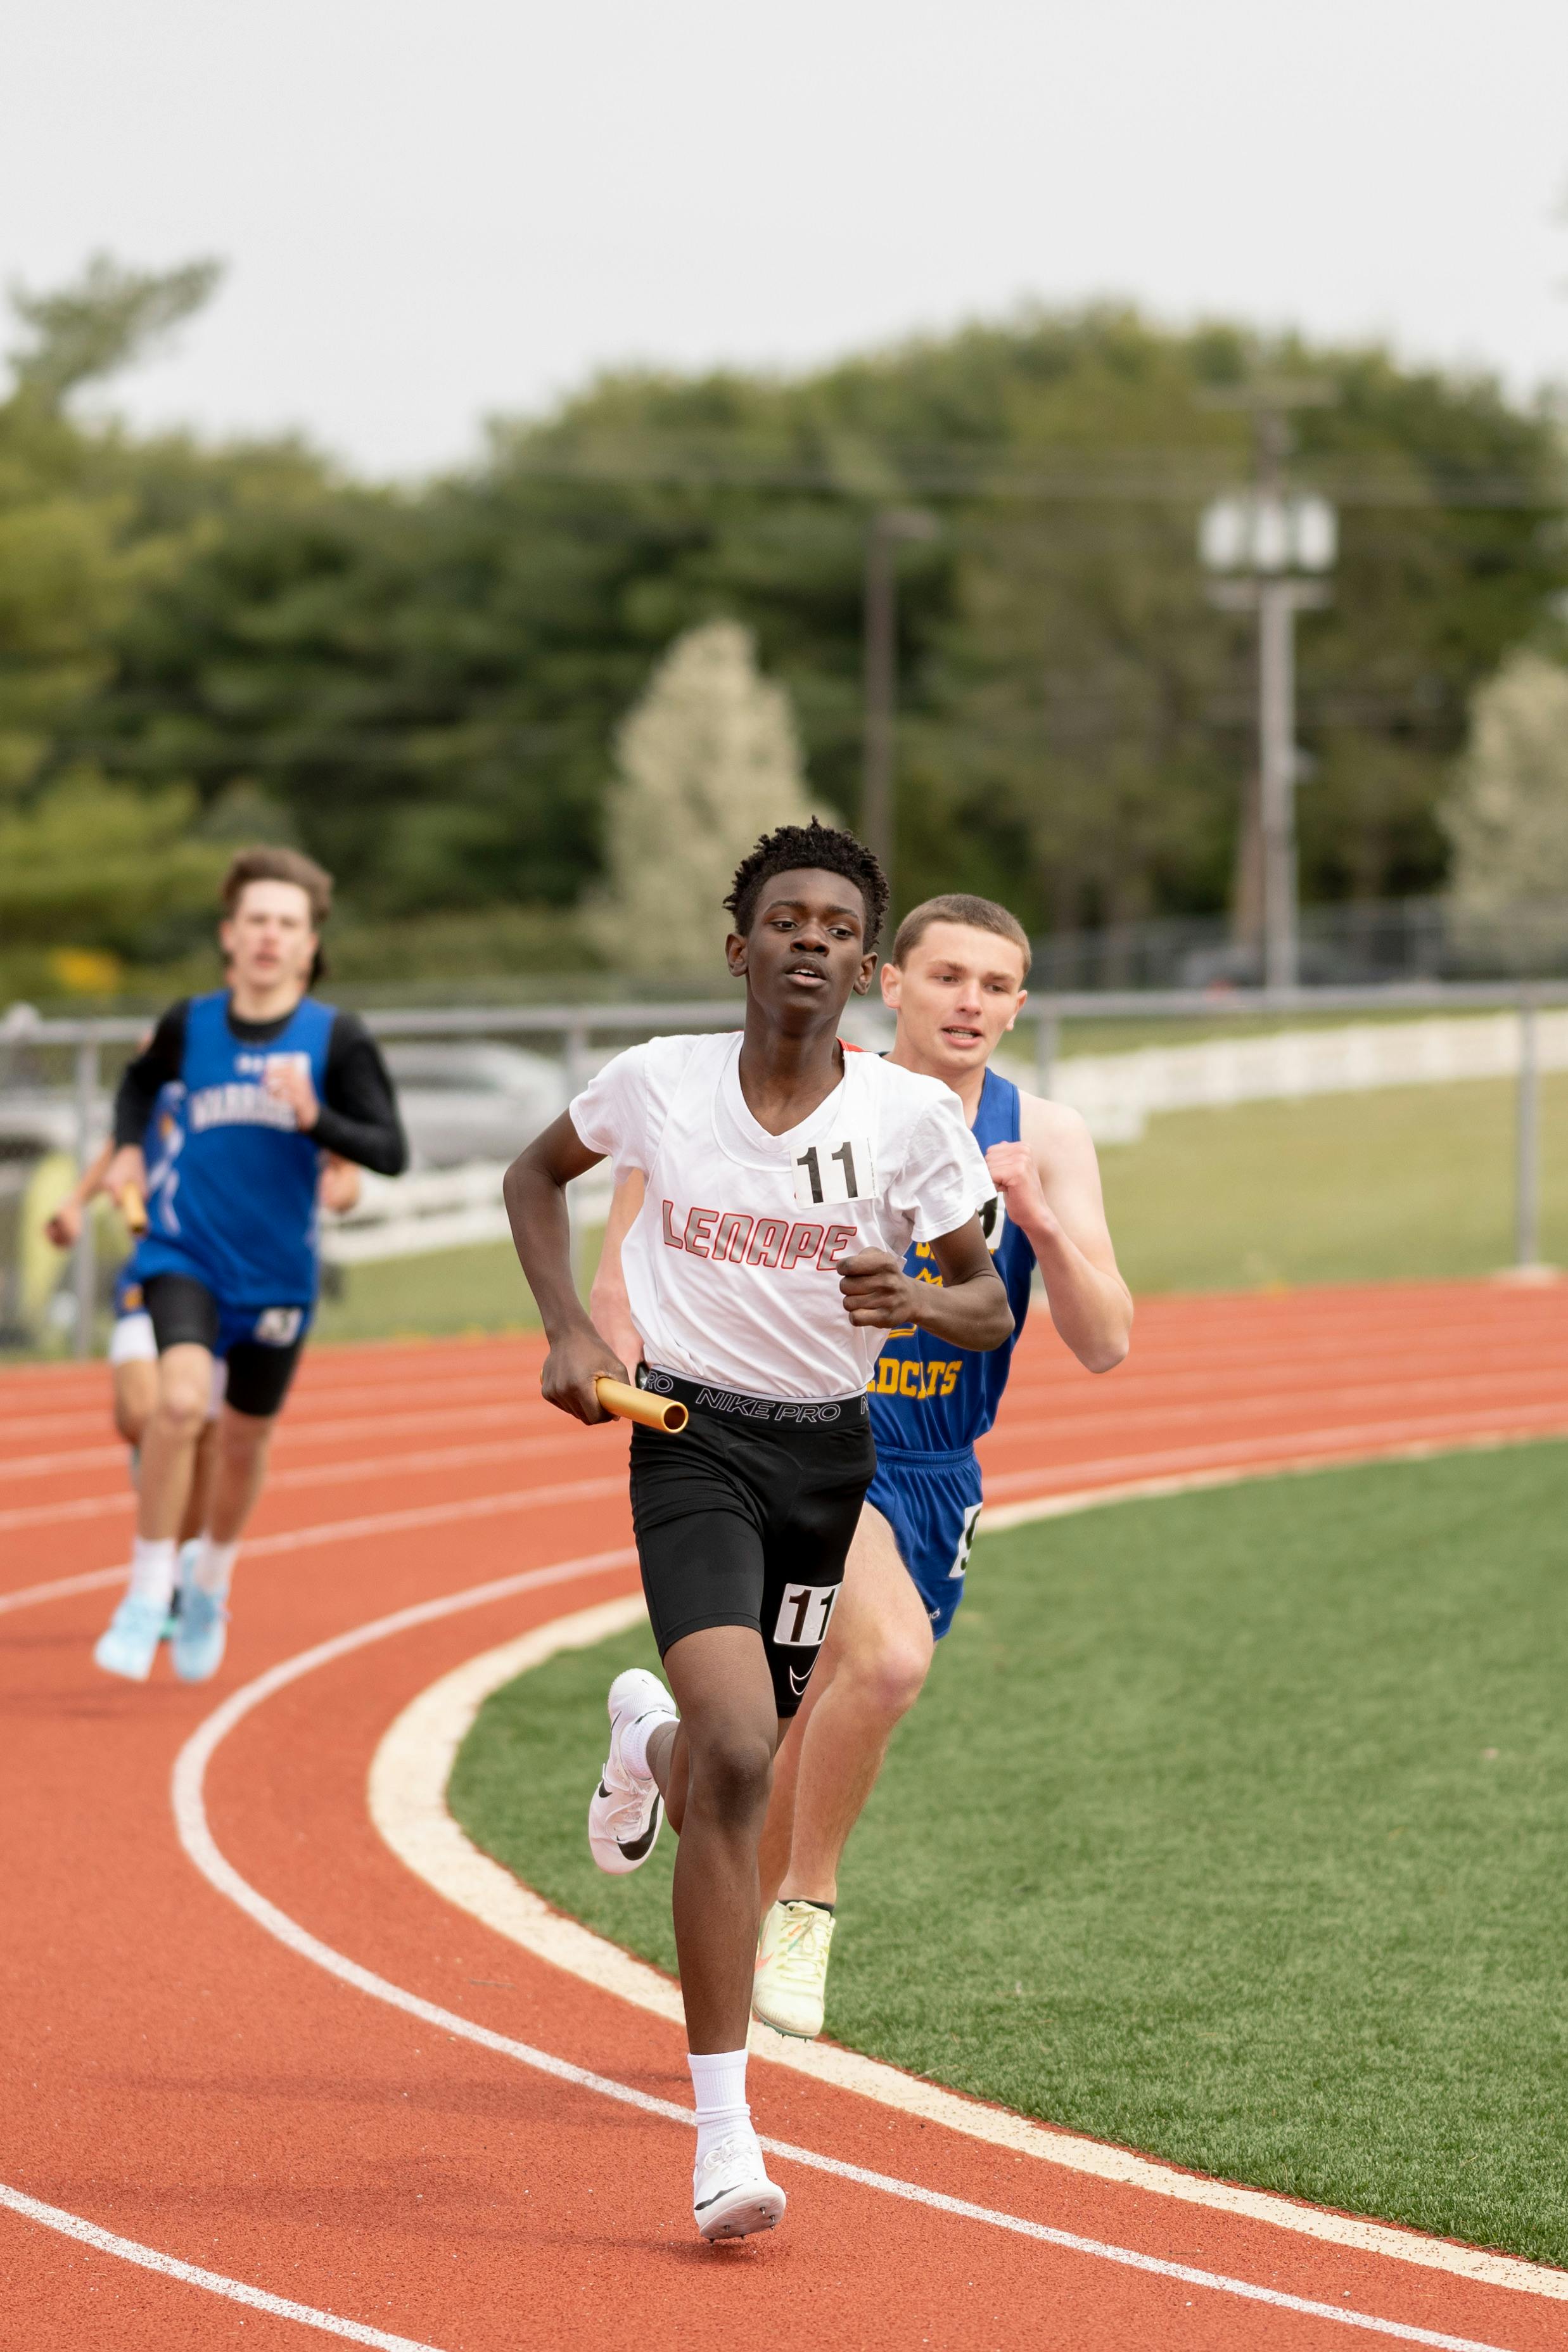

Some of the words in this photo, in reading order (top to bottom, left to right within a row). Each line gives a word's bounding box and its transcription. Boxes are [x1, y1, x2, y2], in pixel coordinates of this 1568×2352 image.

[796, 1141, 858, 1204] 11
[663, 1199, 857, 1270] LENAPE
[696, 1388, 775, 1420] NIKE
[775, 1403, 841, 1422] PRO
[788, 1588, 836, 1643] 11
